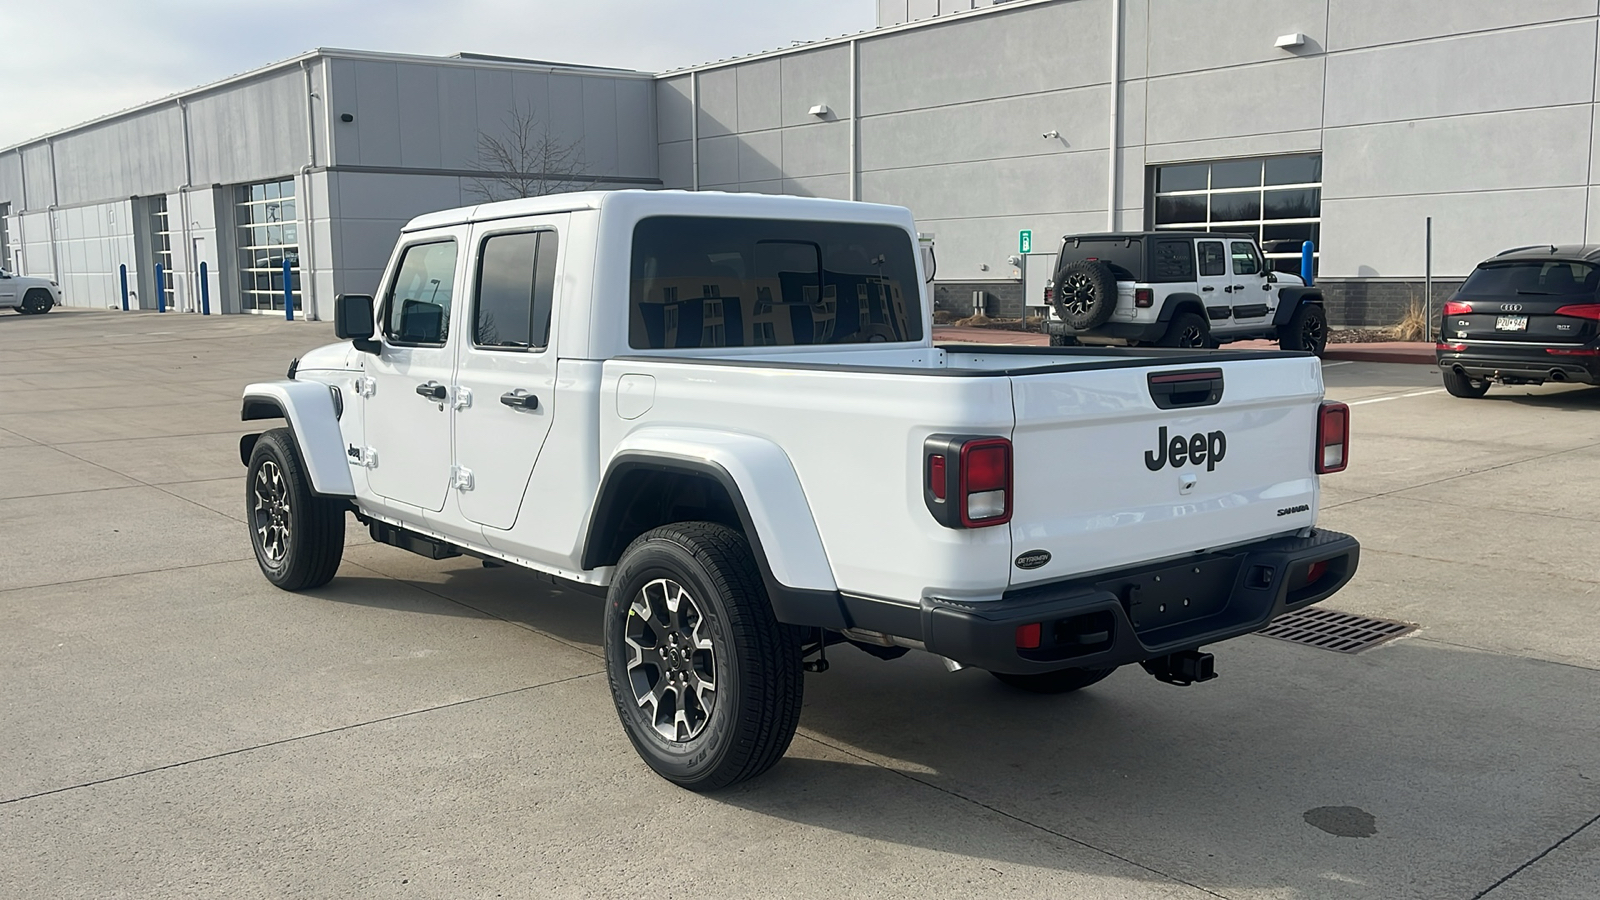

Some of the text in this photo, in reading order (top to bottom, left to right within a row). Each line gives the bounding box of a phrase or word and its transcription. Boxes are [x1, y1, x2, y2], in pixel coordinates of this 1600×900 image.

[348, 443, 360, 460] Jeep
[1144, 425, 1227, 472] Jeep
[1277, 504, 1309, 516] SAHARA
